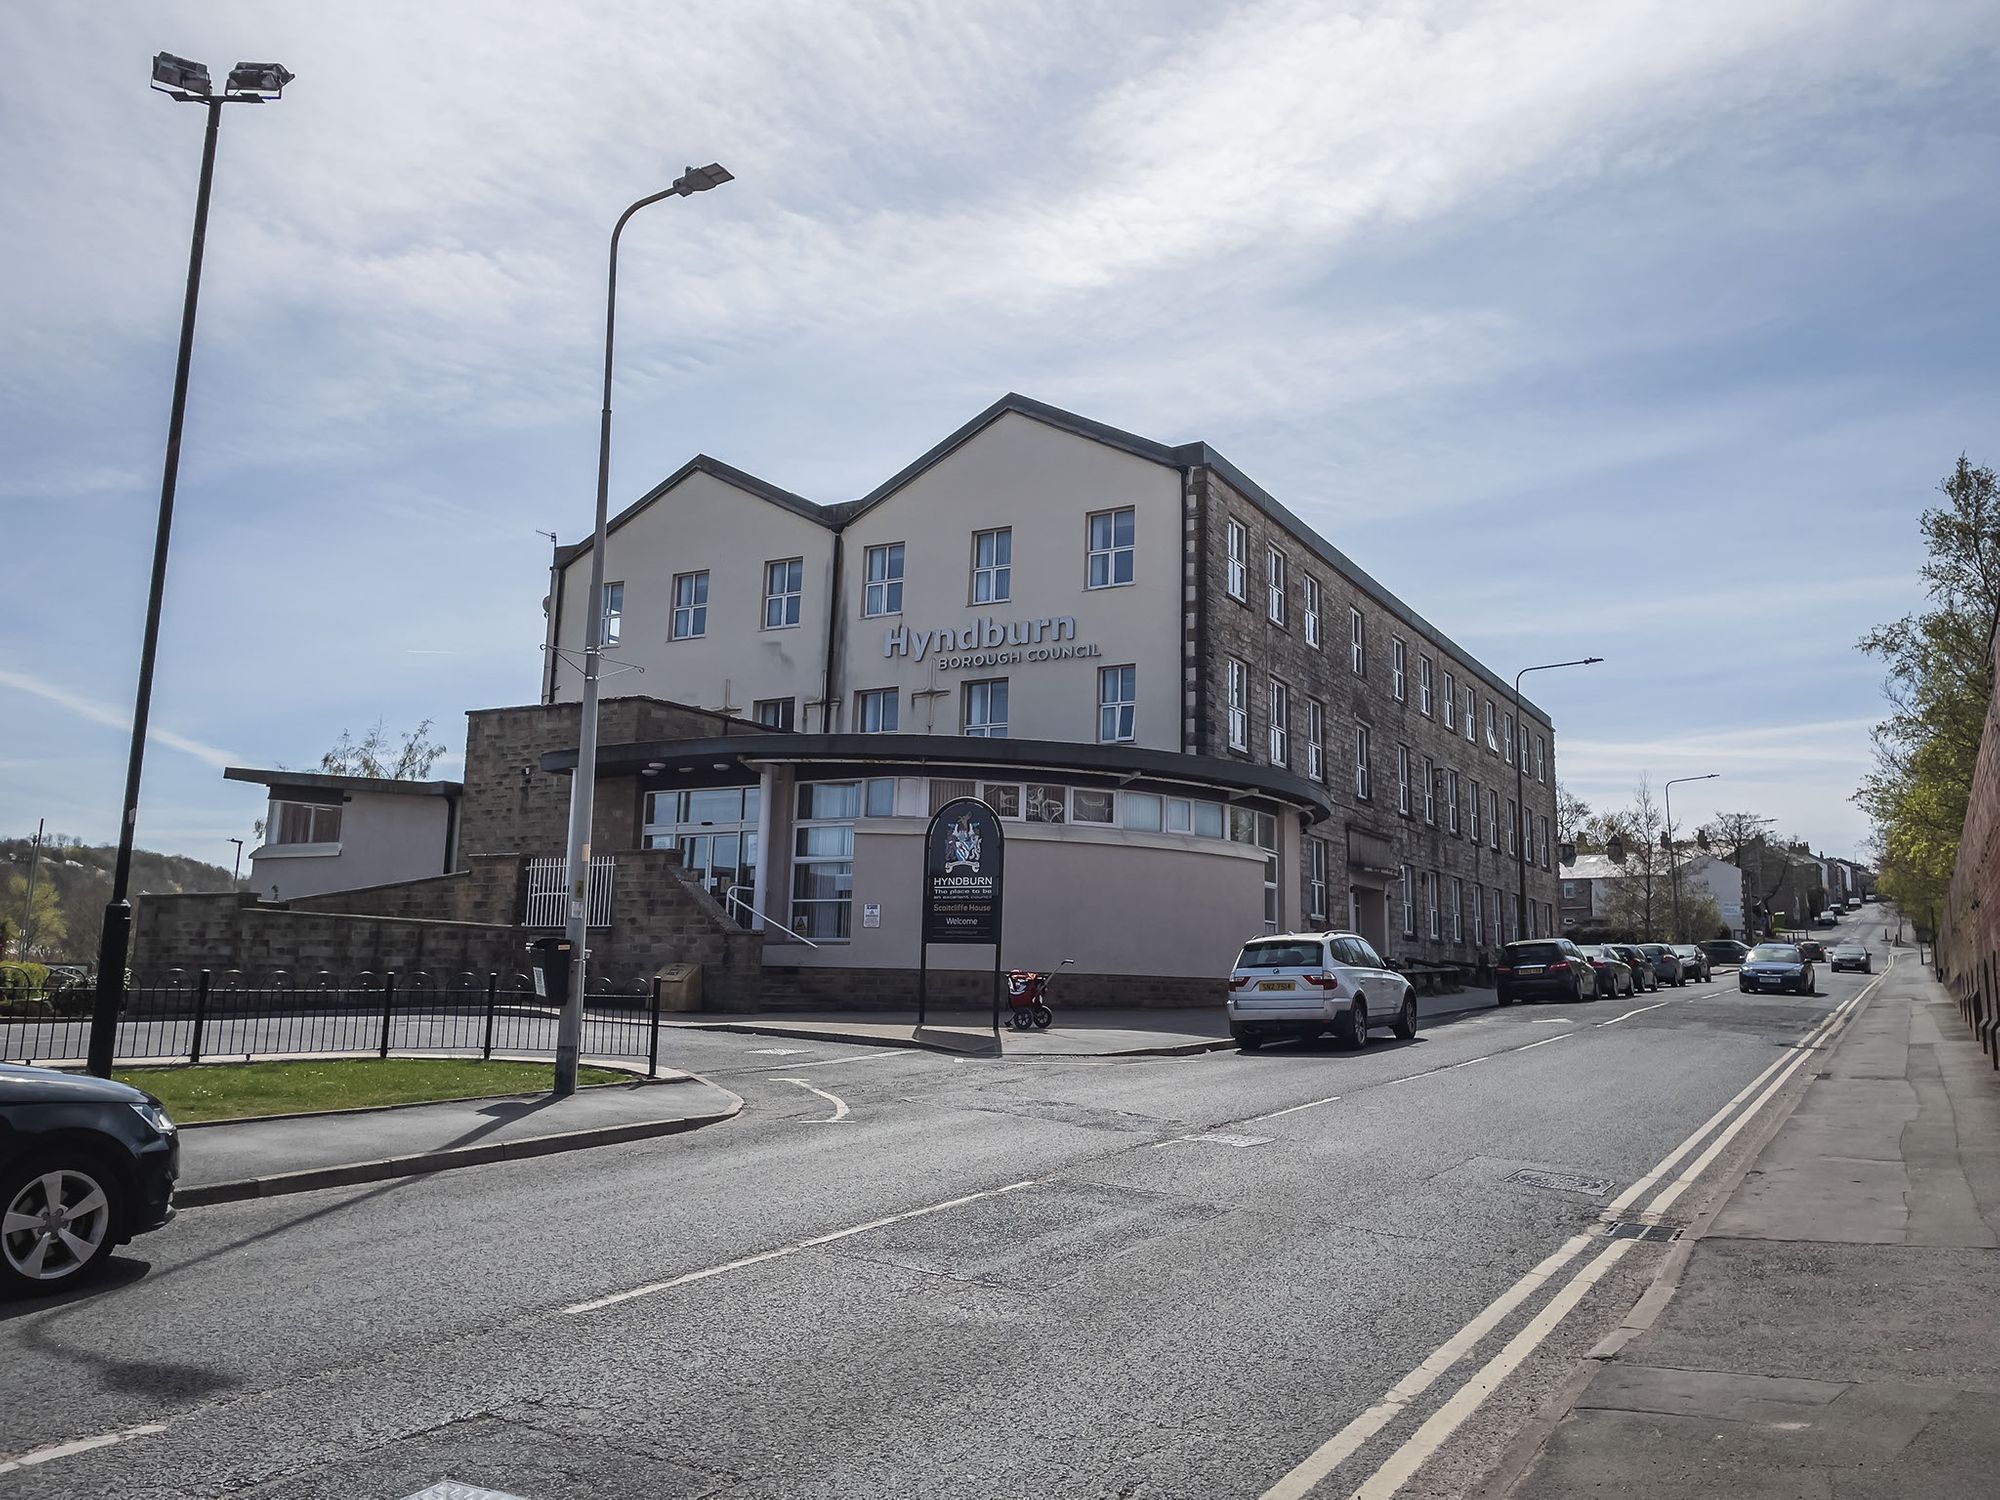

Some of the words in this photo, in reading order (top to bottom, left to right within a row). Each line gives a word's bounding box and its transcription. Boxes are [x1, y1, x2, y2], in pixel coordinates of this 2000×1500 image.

[884, 615, 1075, 662] Hyndburn
[938, 653, 1021, 671] BOROUGH
[1026, 643, 1102, 662] COUNCIL
[933, 877, 993, 886] HYNDBURN
[945, 917, 978, 925] Welcome
